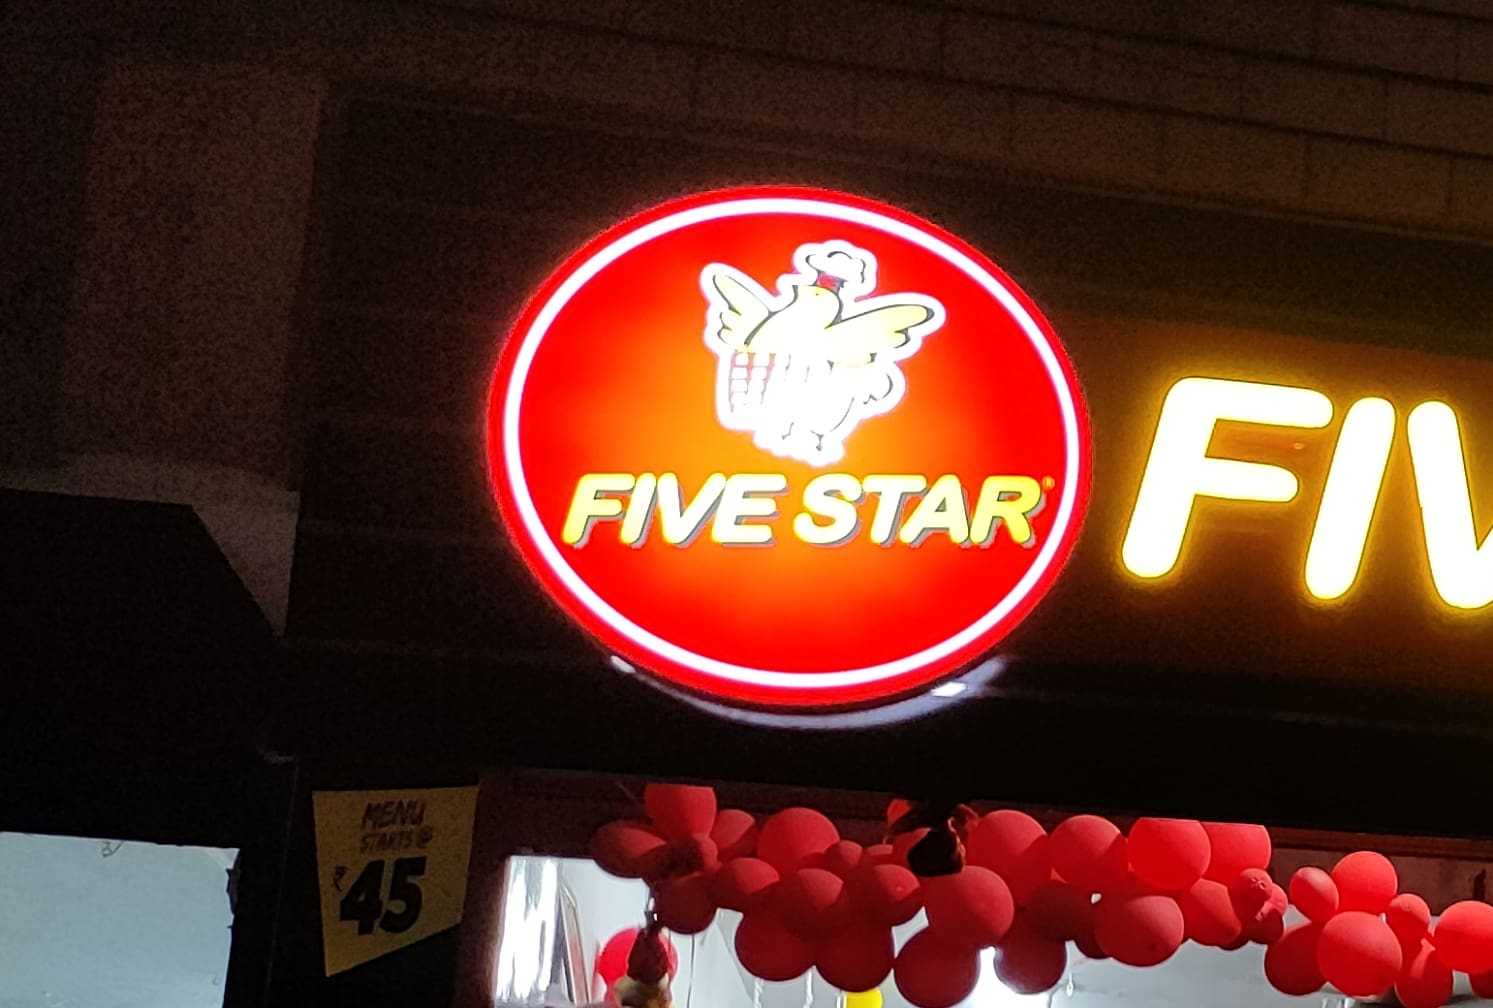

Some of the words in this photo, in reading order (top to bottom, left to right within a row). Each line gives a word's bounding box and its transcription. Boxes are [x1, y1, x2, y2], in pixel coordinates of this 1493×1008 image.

[561, 472, 786, 548] FIVE
[793, 472, 1043, 548] STAR
[362, 801, 426, 829] MENU
